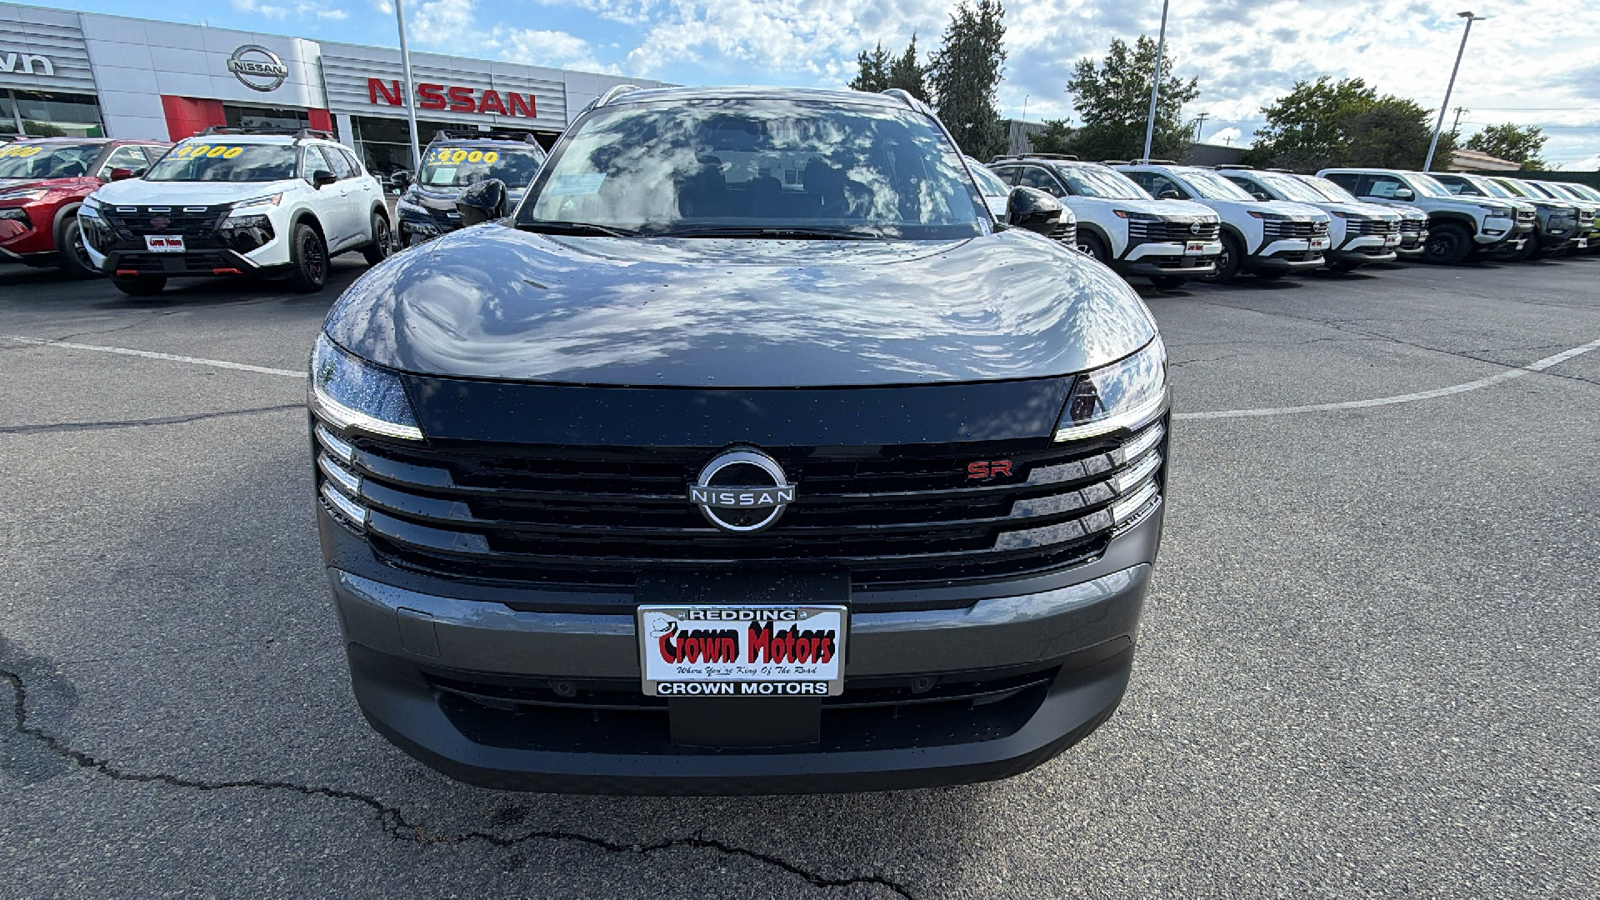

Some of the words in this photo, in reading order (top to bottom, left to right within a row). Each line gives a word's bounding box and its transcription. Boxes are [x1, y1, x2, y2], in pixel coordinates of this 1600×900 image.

[233, 62, 283, 74] NISSAN
[367, 78, 537, 118] NSSAN
[968, 460, 1012, 479] SR
[692, 489, 793, 505] NISSAN
[689, 610, 796, 620] REDDING
[658, 622, 740, 664] Crown
[748, 621, 836, 664] Motors
[676, 666, 702, 674] Where
[705, 666, 733, 677] You're
[736, 666, 757, 676] King
[761, 666, 772, 676] Of
[775, 666, 790, 674] The
[794, 666, 817, 674] Road
[658, 683, 735, 694] CROWN
[741, 682, 828, 694] MOTORS
